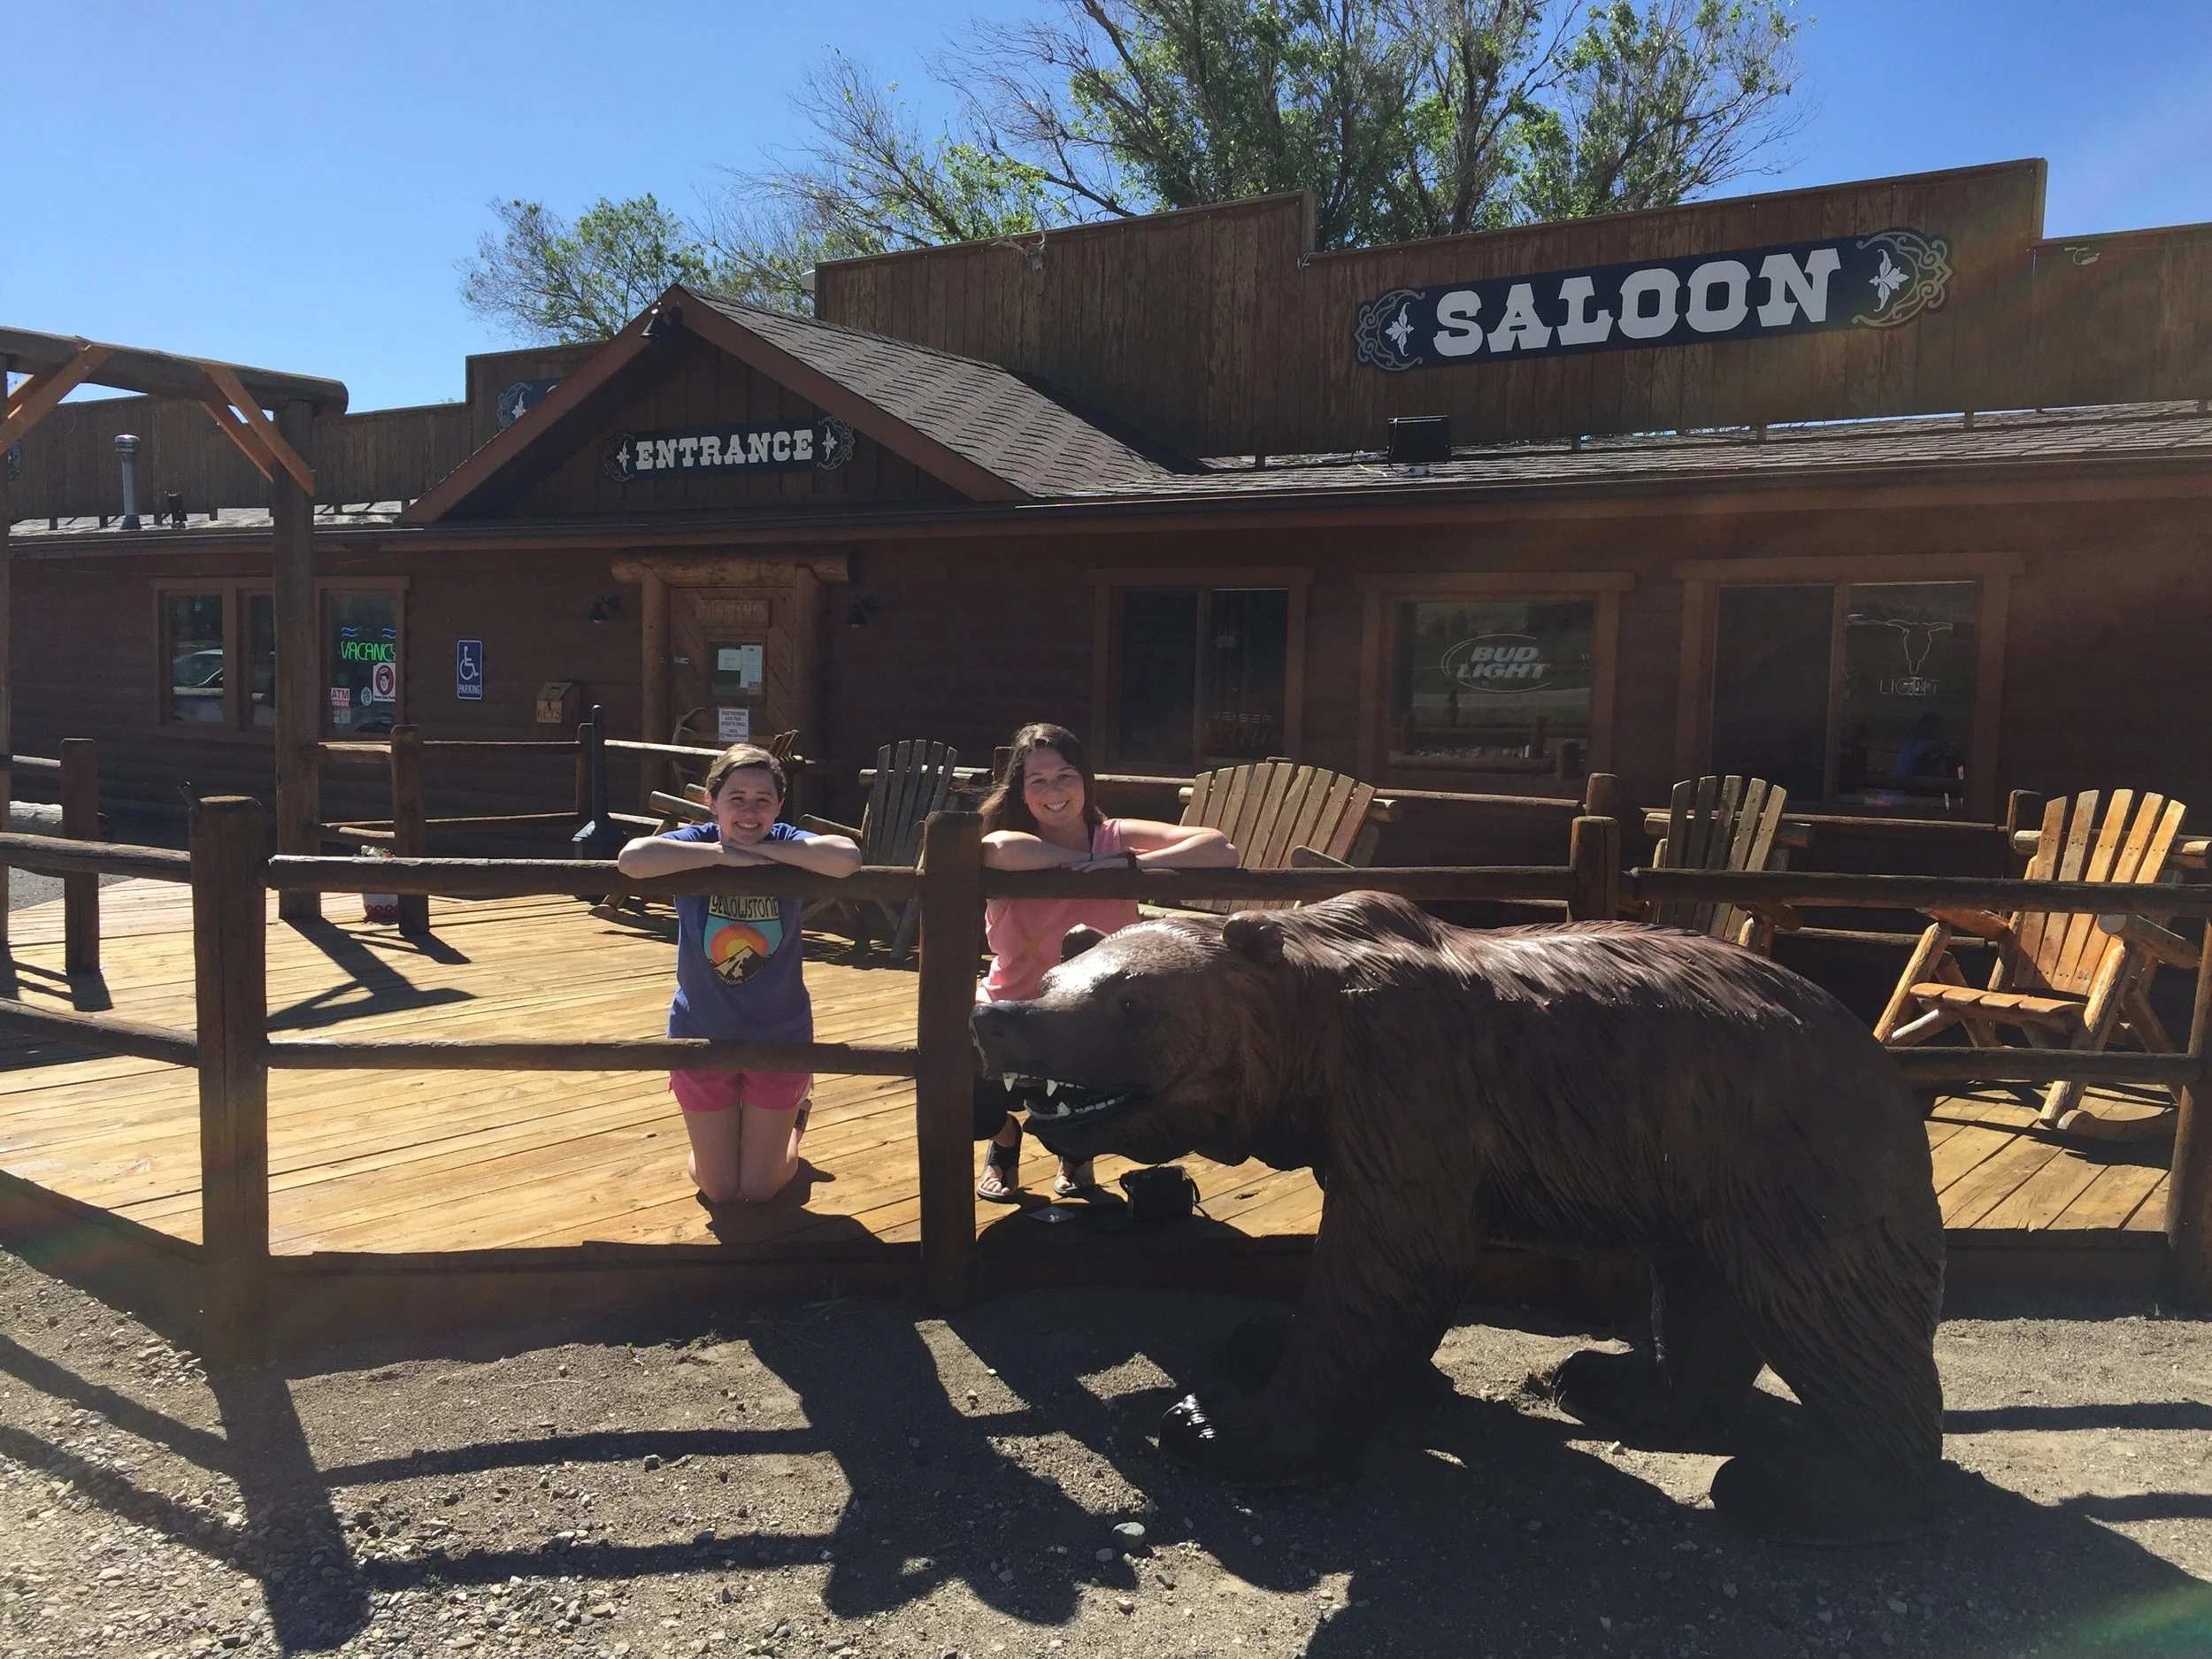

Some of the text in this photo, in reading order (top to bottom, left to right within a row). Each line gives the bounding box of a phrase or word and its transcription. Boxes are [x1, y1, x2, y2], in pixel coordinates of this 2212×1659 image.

[1432, 247, 1841, 357] SALOON
[635, 428, 814, 471] ENTRANCE
[1471, 646, 1540, 663] BUD
[1456, 663, 1551, 680] LIGHT
[332, 689, 349, 699] ATM
[458, 684, 480, 694] PARKING
[538, 708, 560, 719] KEYS
[711, 895, 779, 918] YELLOWSTONE
